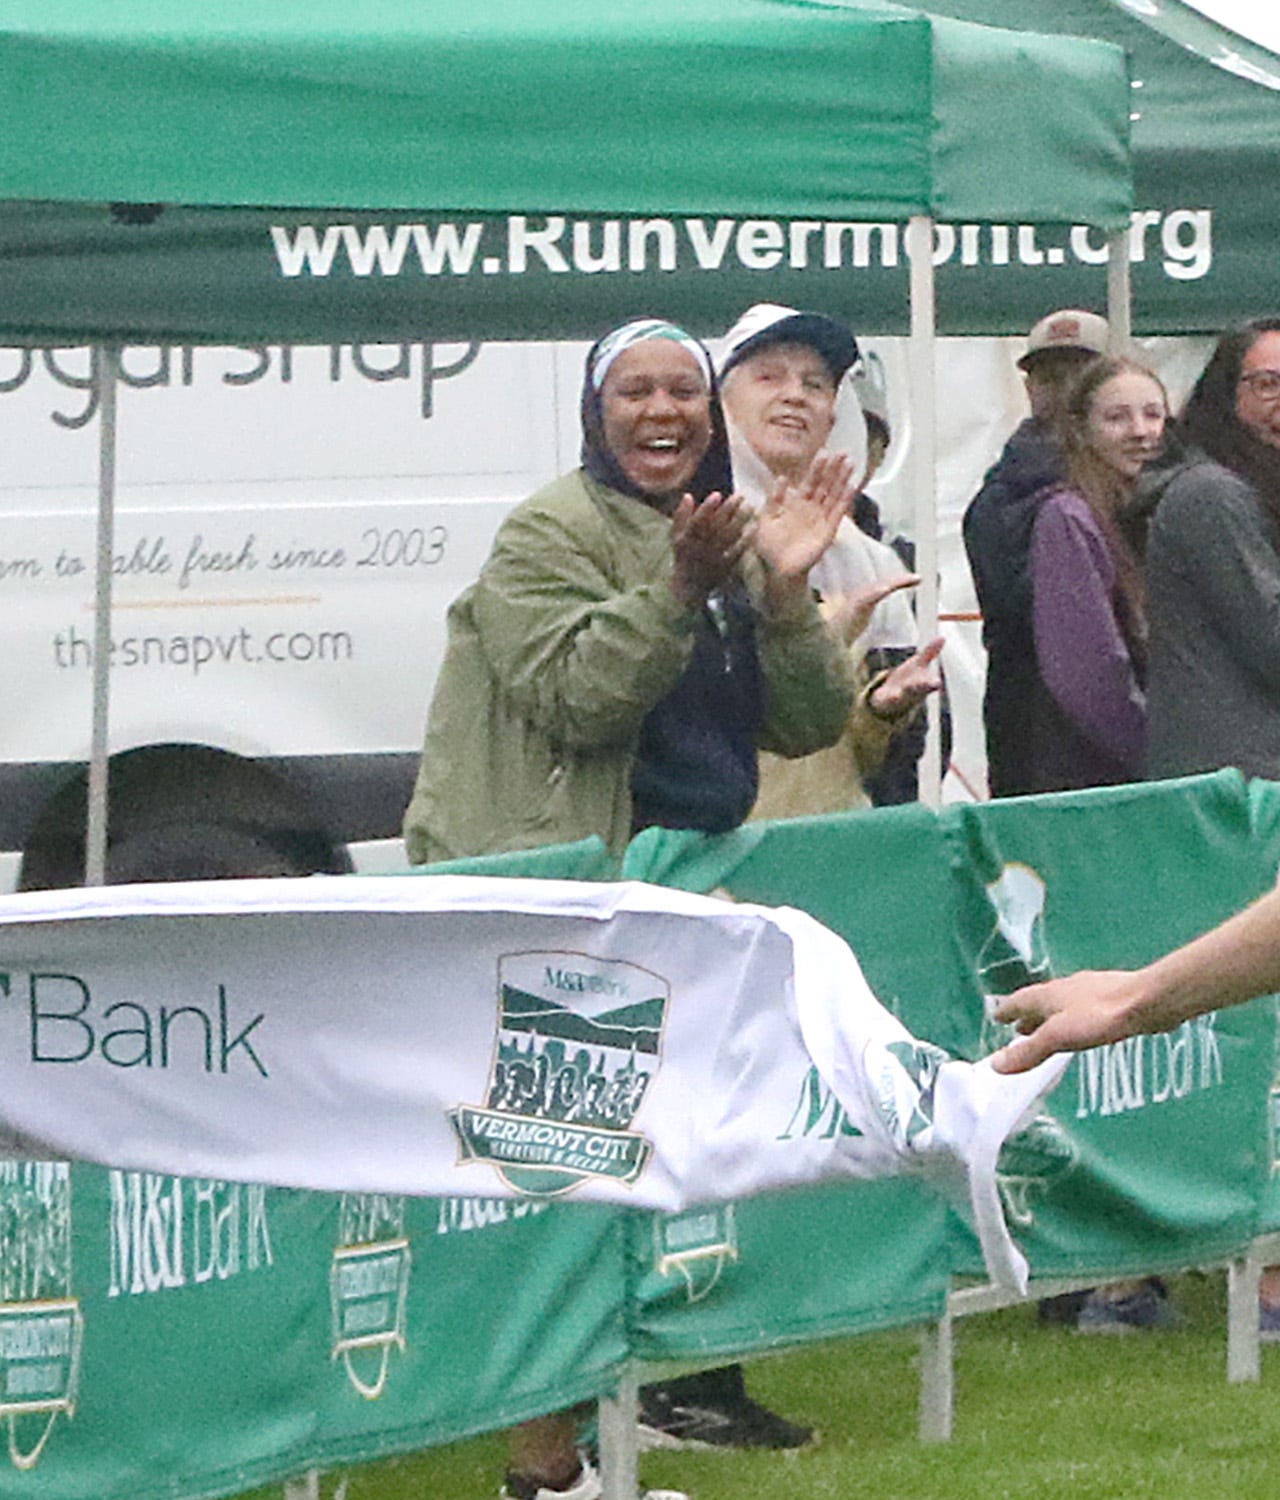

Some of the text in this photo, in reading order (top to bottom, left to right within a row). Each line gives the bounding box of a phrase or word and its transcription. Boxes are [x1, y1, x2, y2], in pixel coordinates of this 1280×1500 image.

[111, 536, 173, 576] able
[178, 534, 258, 590] fresh
[267, 545, 347, 571] since
[356, 526, 448, 568] 2003
[541, 966, 586, 993] M&T
[30, 972, 269, 1078] Bank
[471, 1114, 633, 1162] VERMONT CITY
